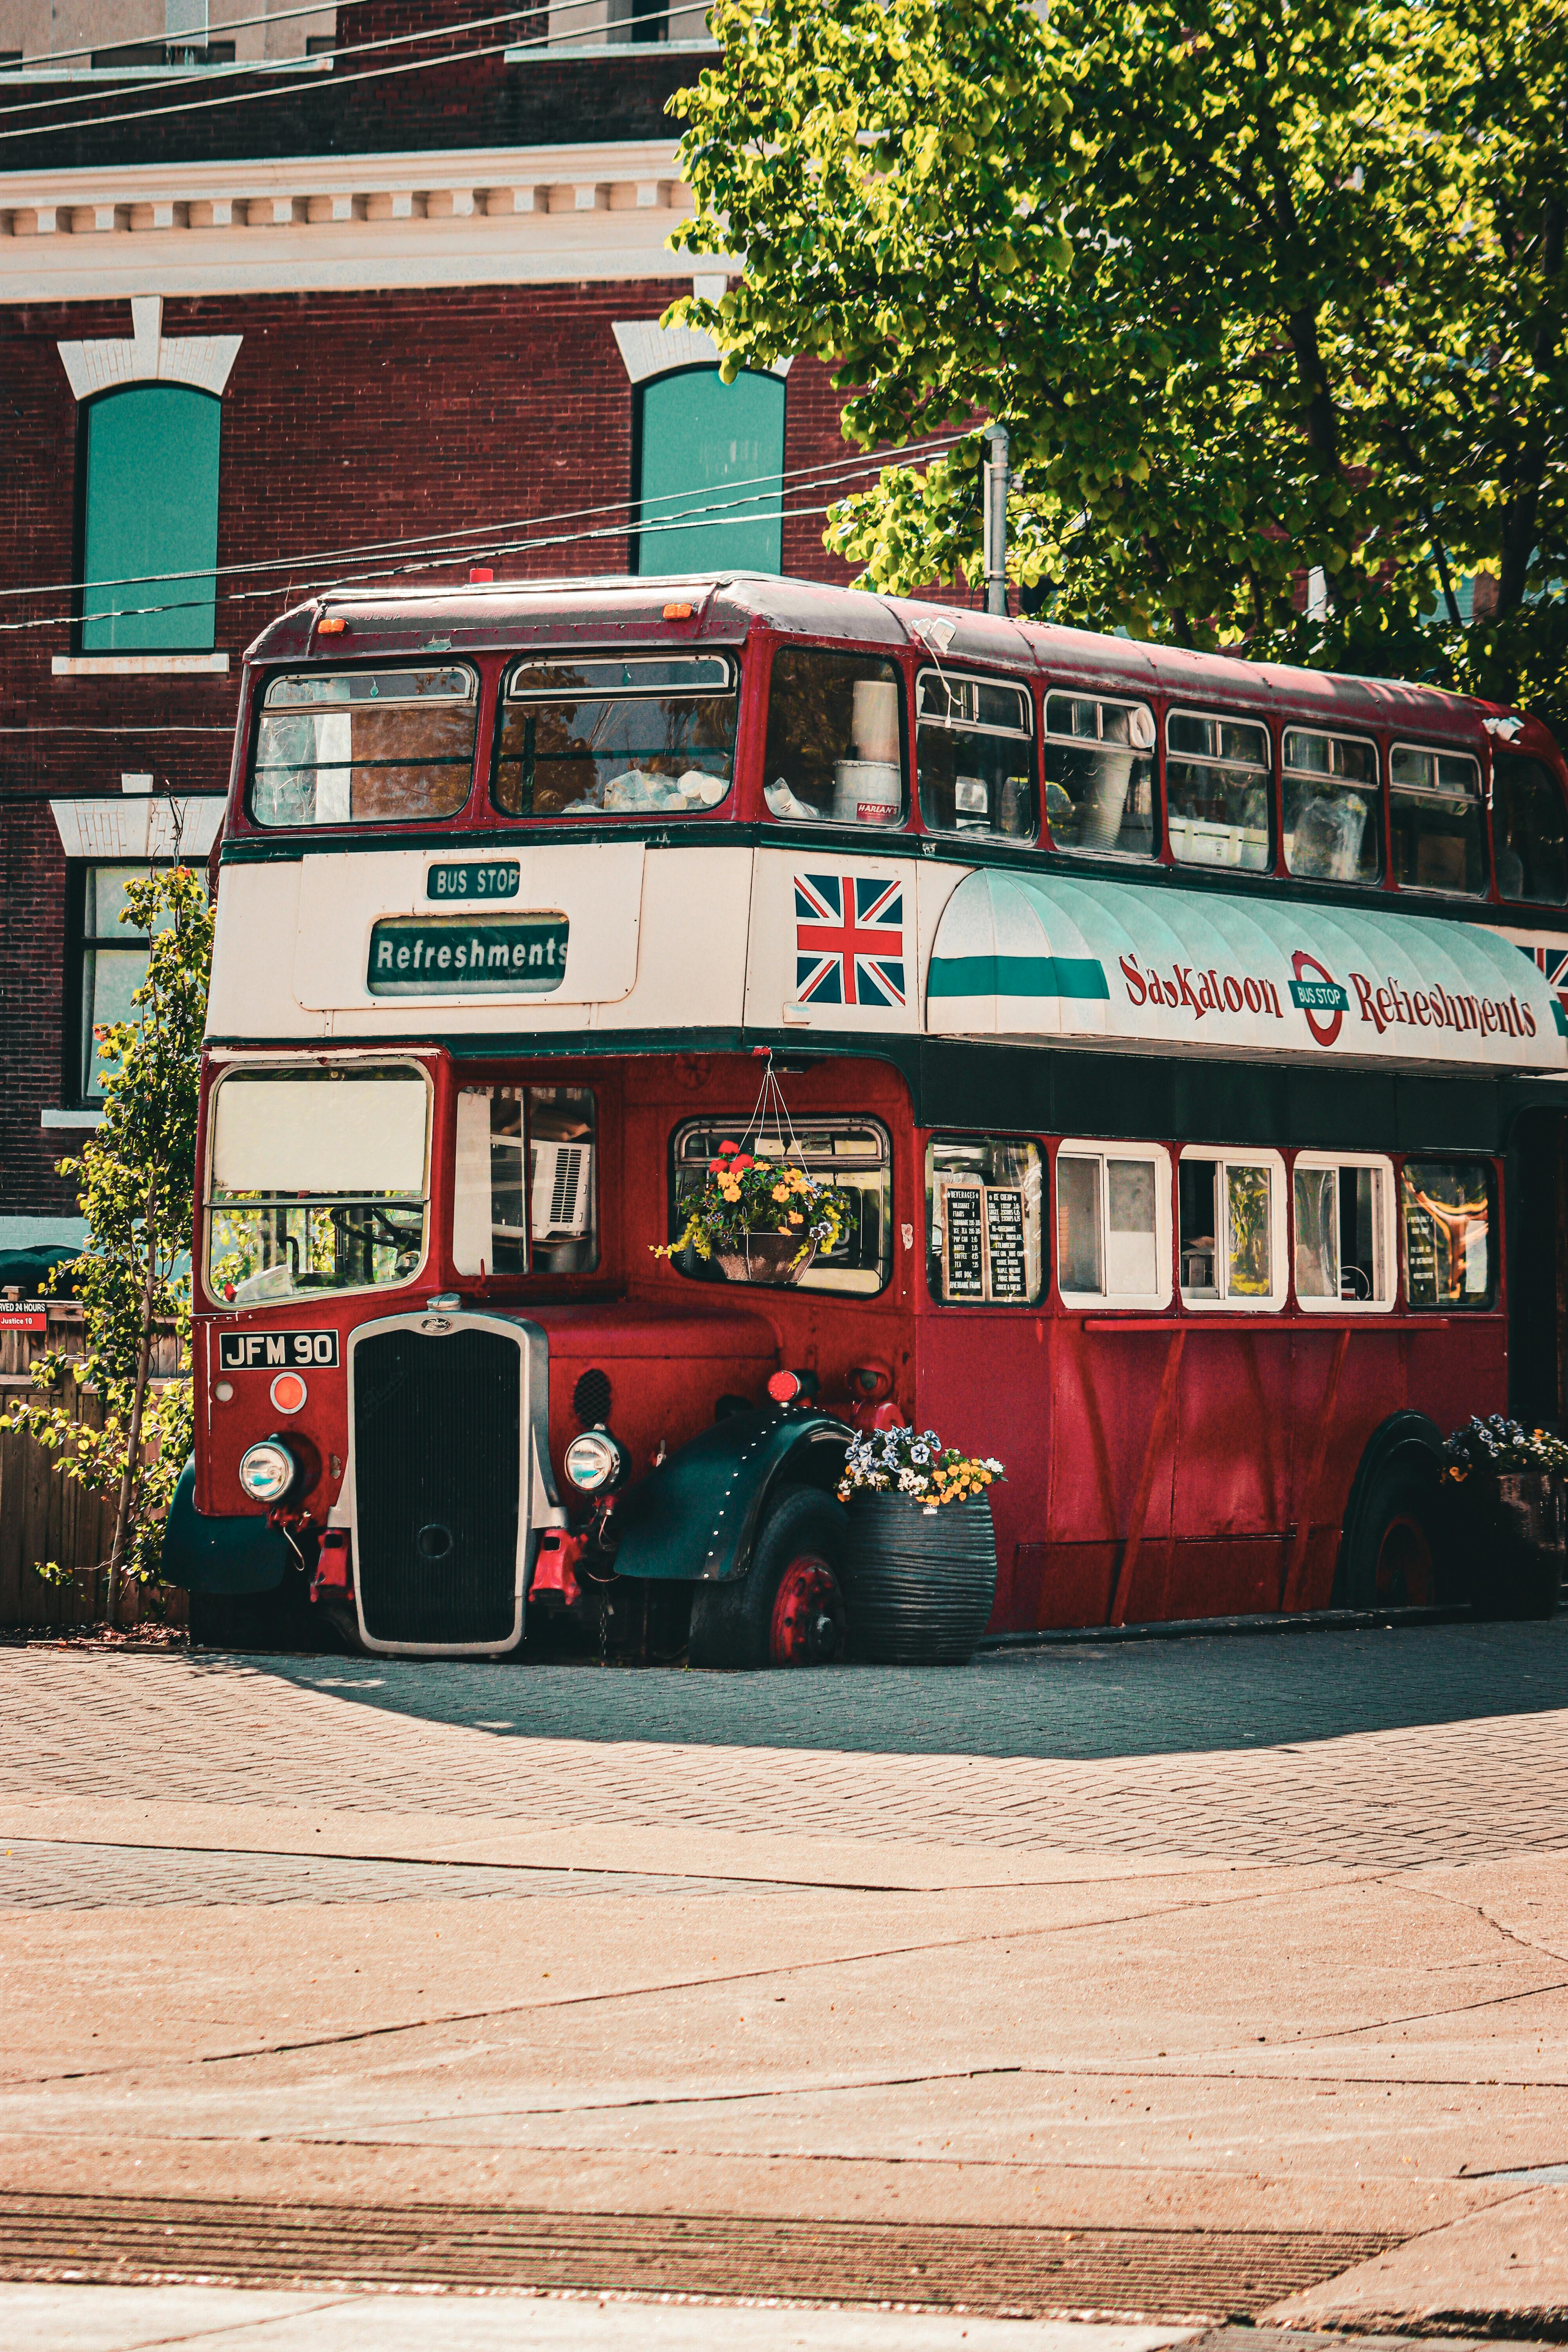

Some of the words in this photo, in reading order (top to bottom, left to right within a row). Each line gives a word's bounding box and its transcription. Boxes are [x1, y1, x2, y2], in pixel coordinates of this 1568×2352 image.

[858, 804, 897, 814] HARLAN'S
[437, 870, 467, 893] BUS
[477, 869, 517, 893] STOP
[377, 937, 568, 969] Refreshments
[1118, 953, 1284, 1020] Saskatoon
[1298, 987, 1315, 1004] BUS
[1316, 988, 1340, 1005] STOP
[1348, 973, 1537, 1038] Refreshments
[15, 1303, 22, 1312] 24
[24, 1303, 45, 1312] HOURS
[226, 1336, 285, 1365] JFM
[294, 1335, 332, 1363] 90
